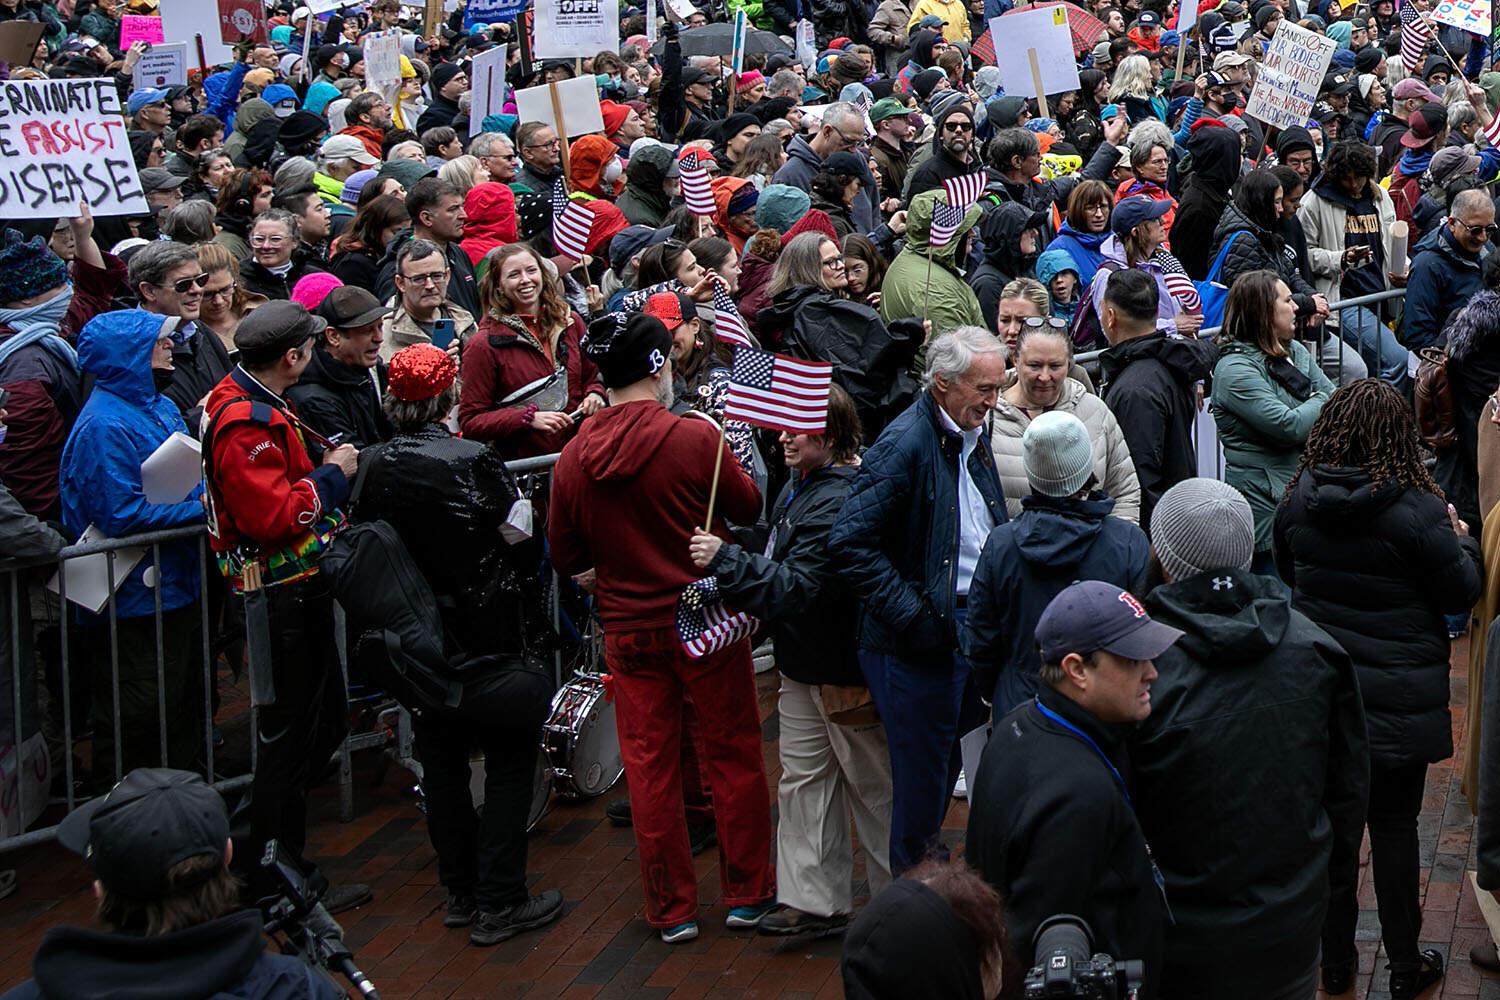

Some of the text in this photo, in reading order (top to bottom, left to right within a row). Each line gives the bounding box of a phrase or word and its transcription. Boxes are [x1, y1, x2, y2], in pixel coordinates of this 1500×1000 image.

[562, 0, 597, 12] OFF!
[1277, 24, 1306, 47] HANDS
[1263, 52, 1321, 87] OUR COURTS
[1270, 36, 1323, 70] OUR BODIES
[21, 119, 122, 155] FASCIST
